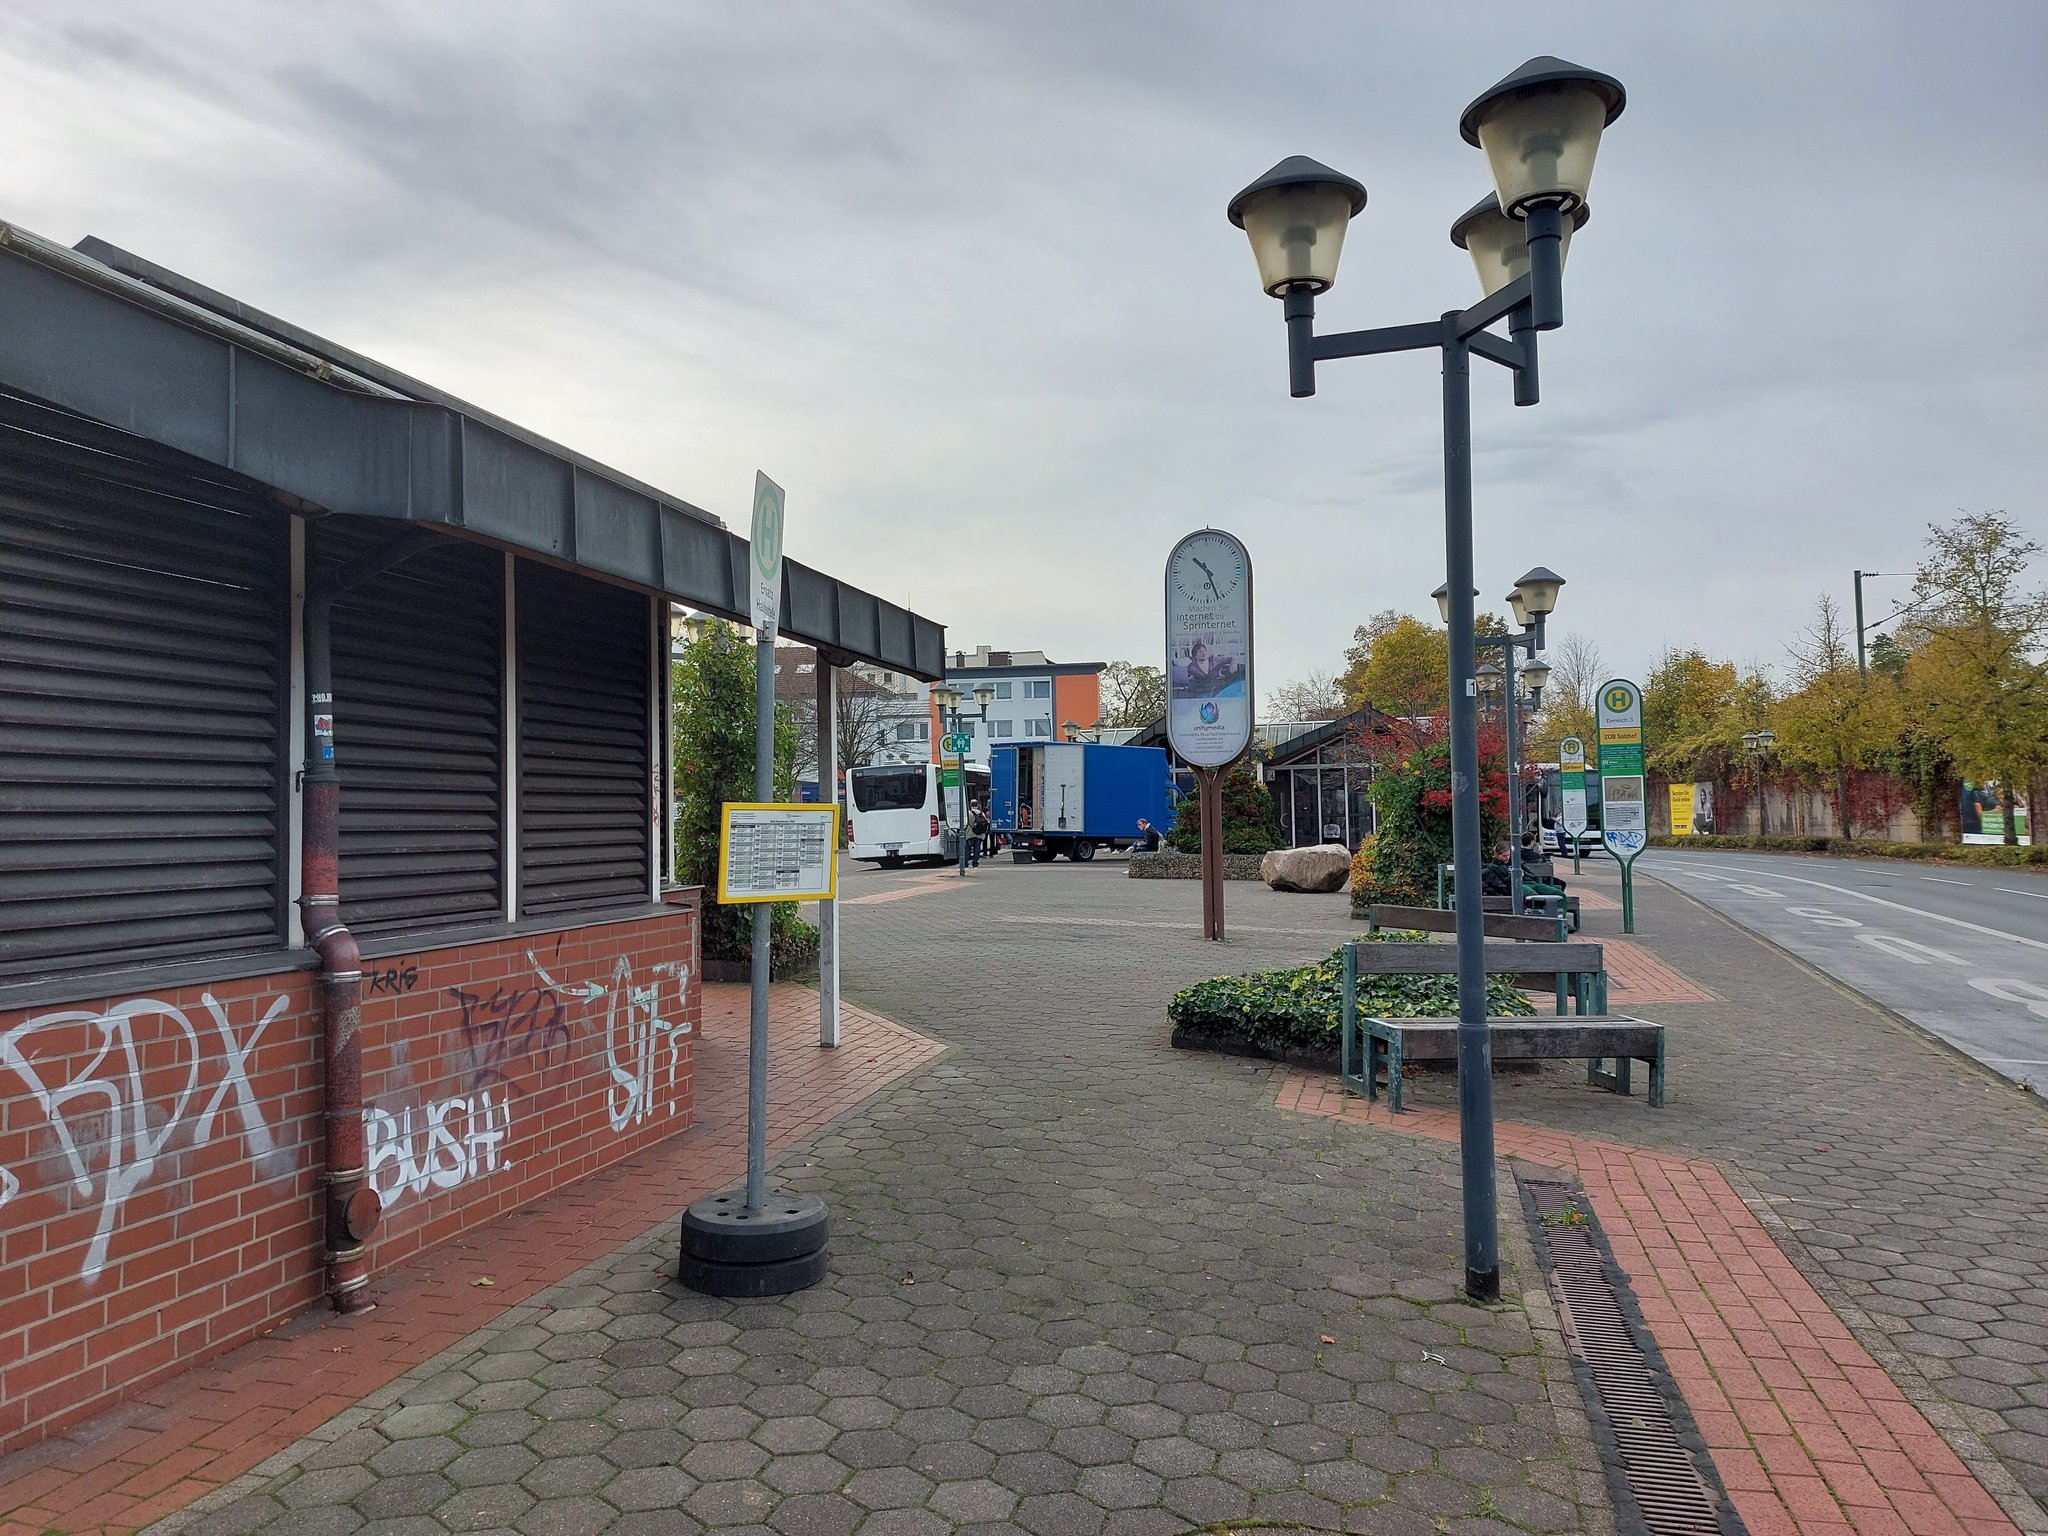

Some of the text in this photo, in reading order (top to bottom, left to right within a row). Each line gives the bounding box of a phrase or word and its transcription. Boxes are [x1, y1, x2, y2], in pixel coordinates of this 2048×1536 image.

[1187, 605, 1217, 613] Machen
[1176, 612, 1214, 622] Internet
[1193, 724, 1225, 732] unitymedia
[1617, 732, 1638, 740] Salzhof
